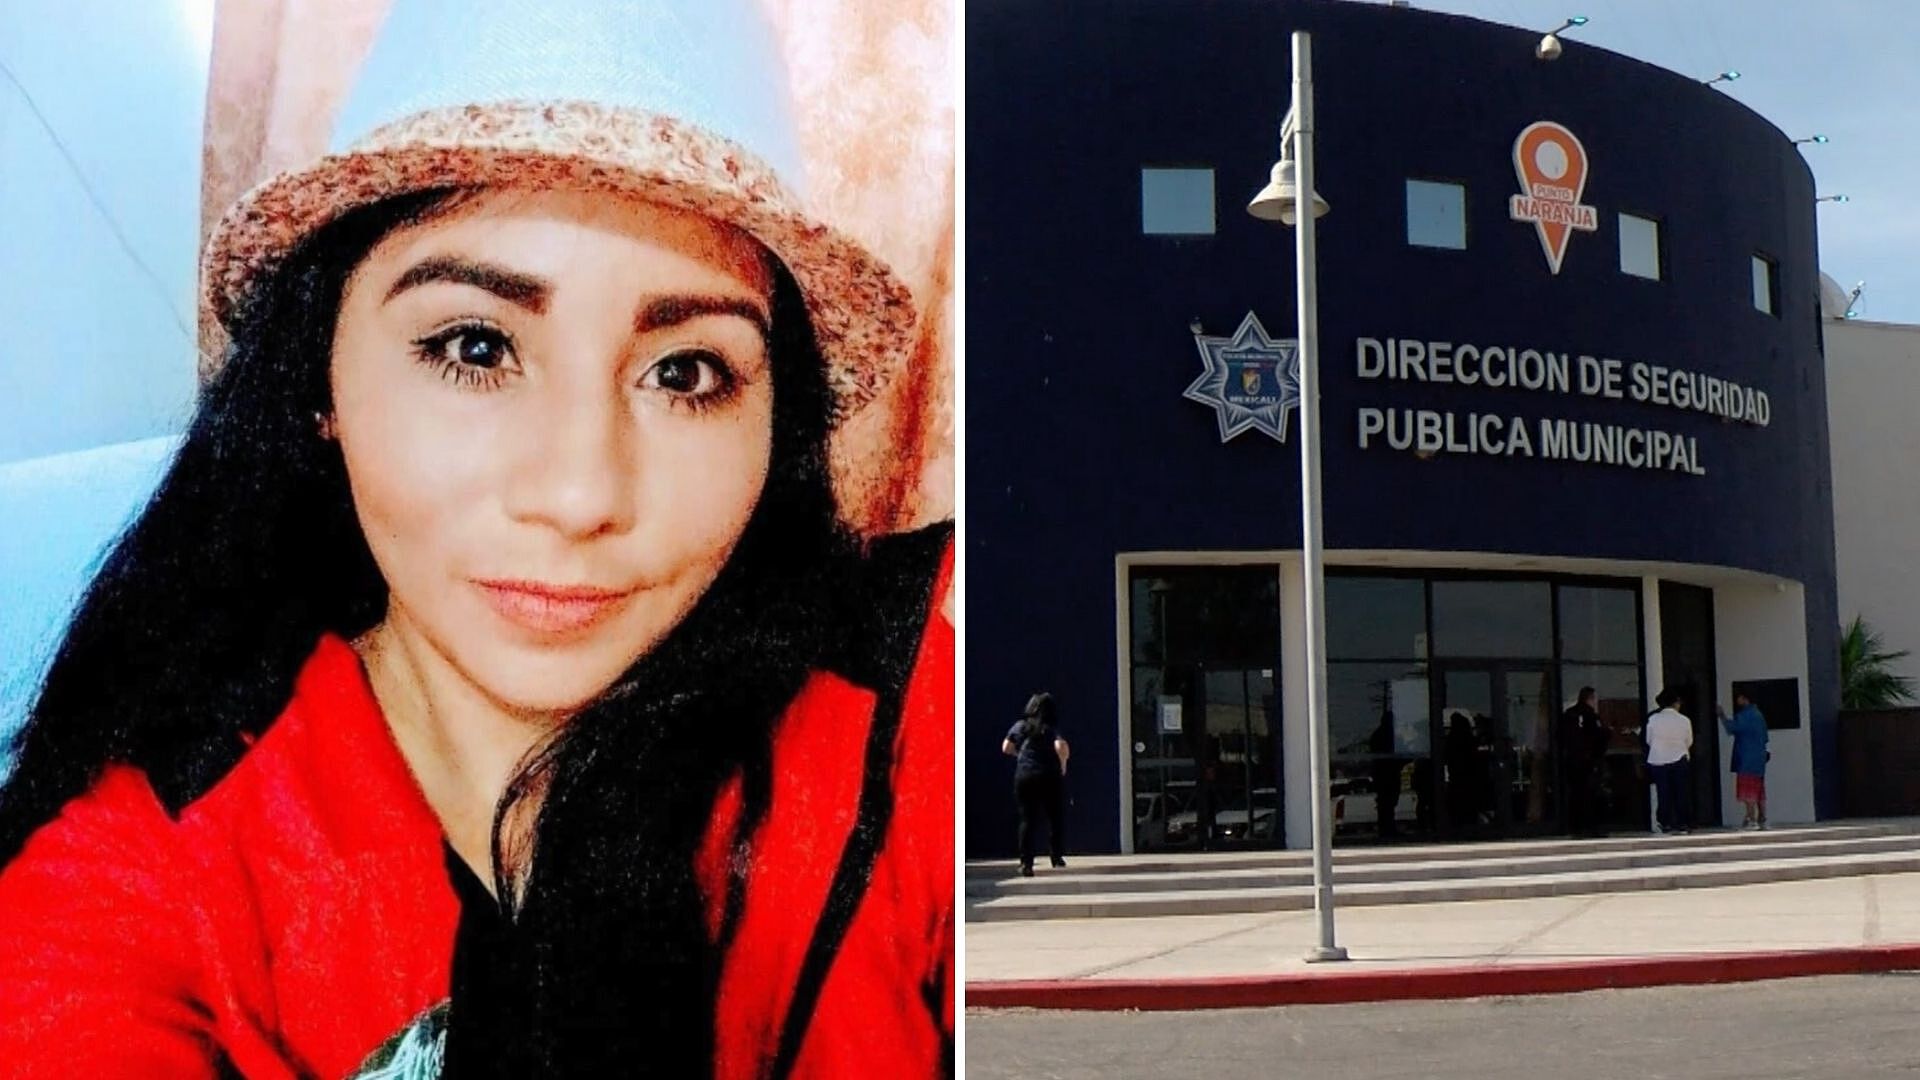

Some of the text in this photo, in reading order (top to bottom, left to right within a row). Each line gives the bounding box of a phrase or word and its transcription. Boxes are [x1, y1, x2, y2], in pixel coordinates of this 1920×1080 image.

[1517, 199, 1593, 226] NARANJA
[1356, 337, 1771, 428] DIRECCION DE SEGURIDAD
[1358, 407, 1706, 475] PUBLICA MUNICIPAL
